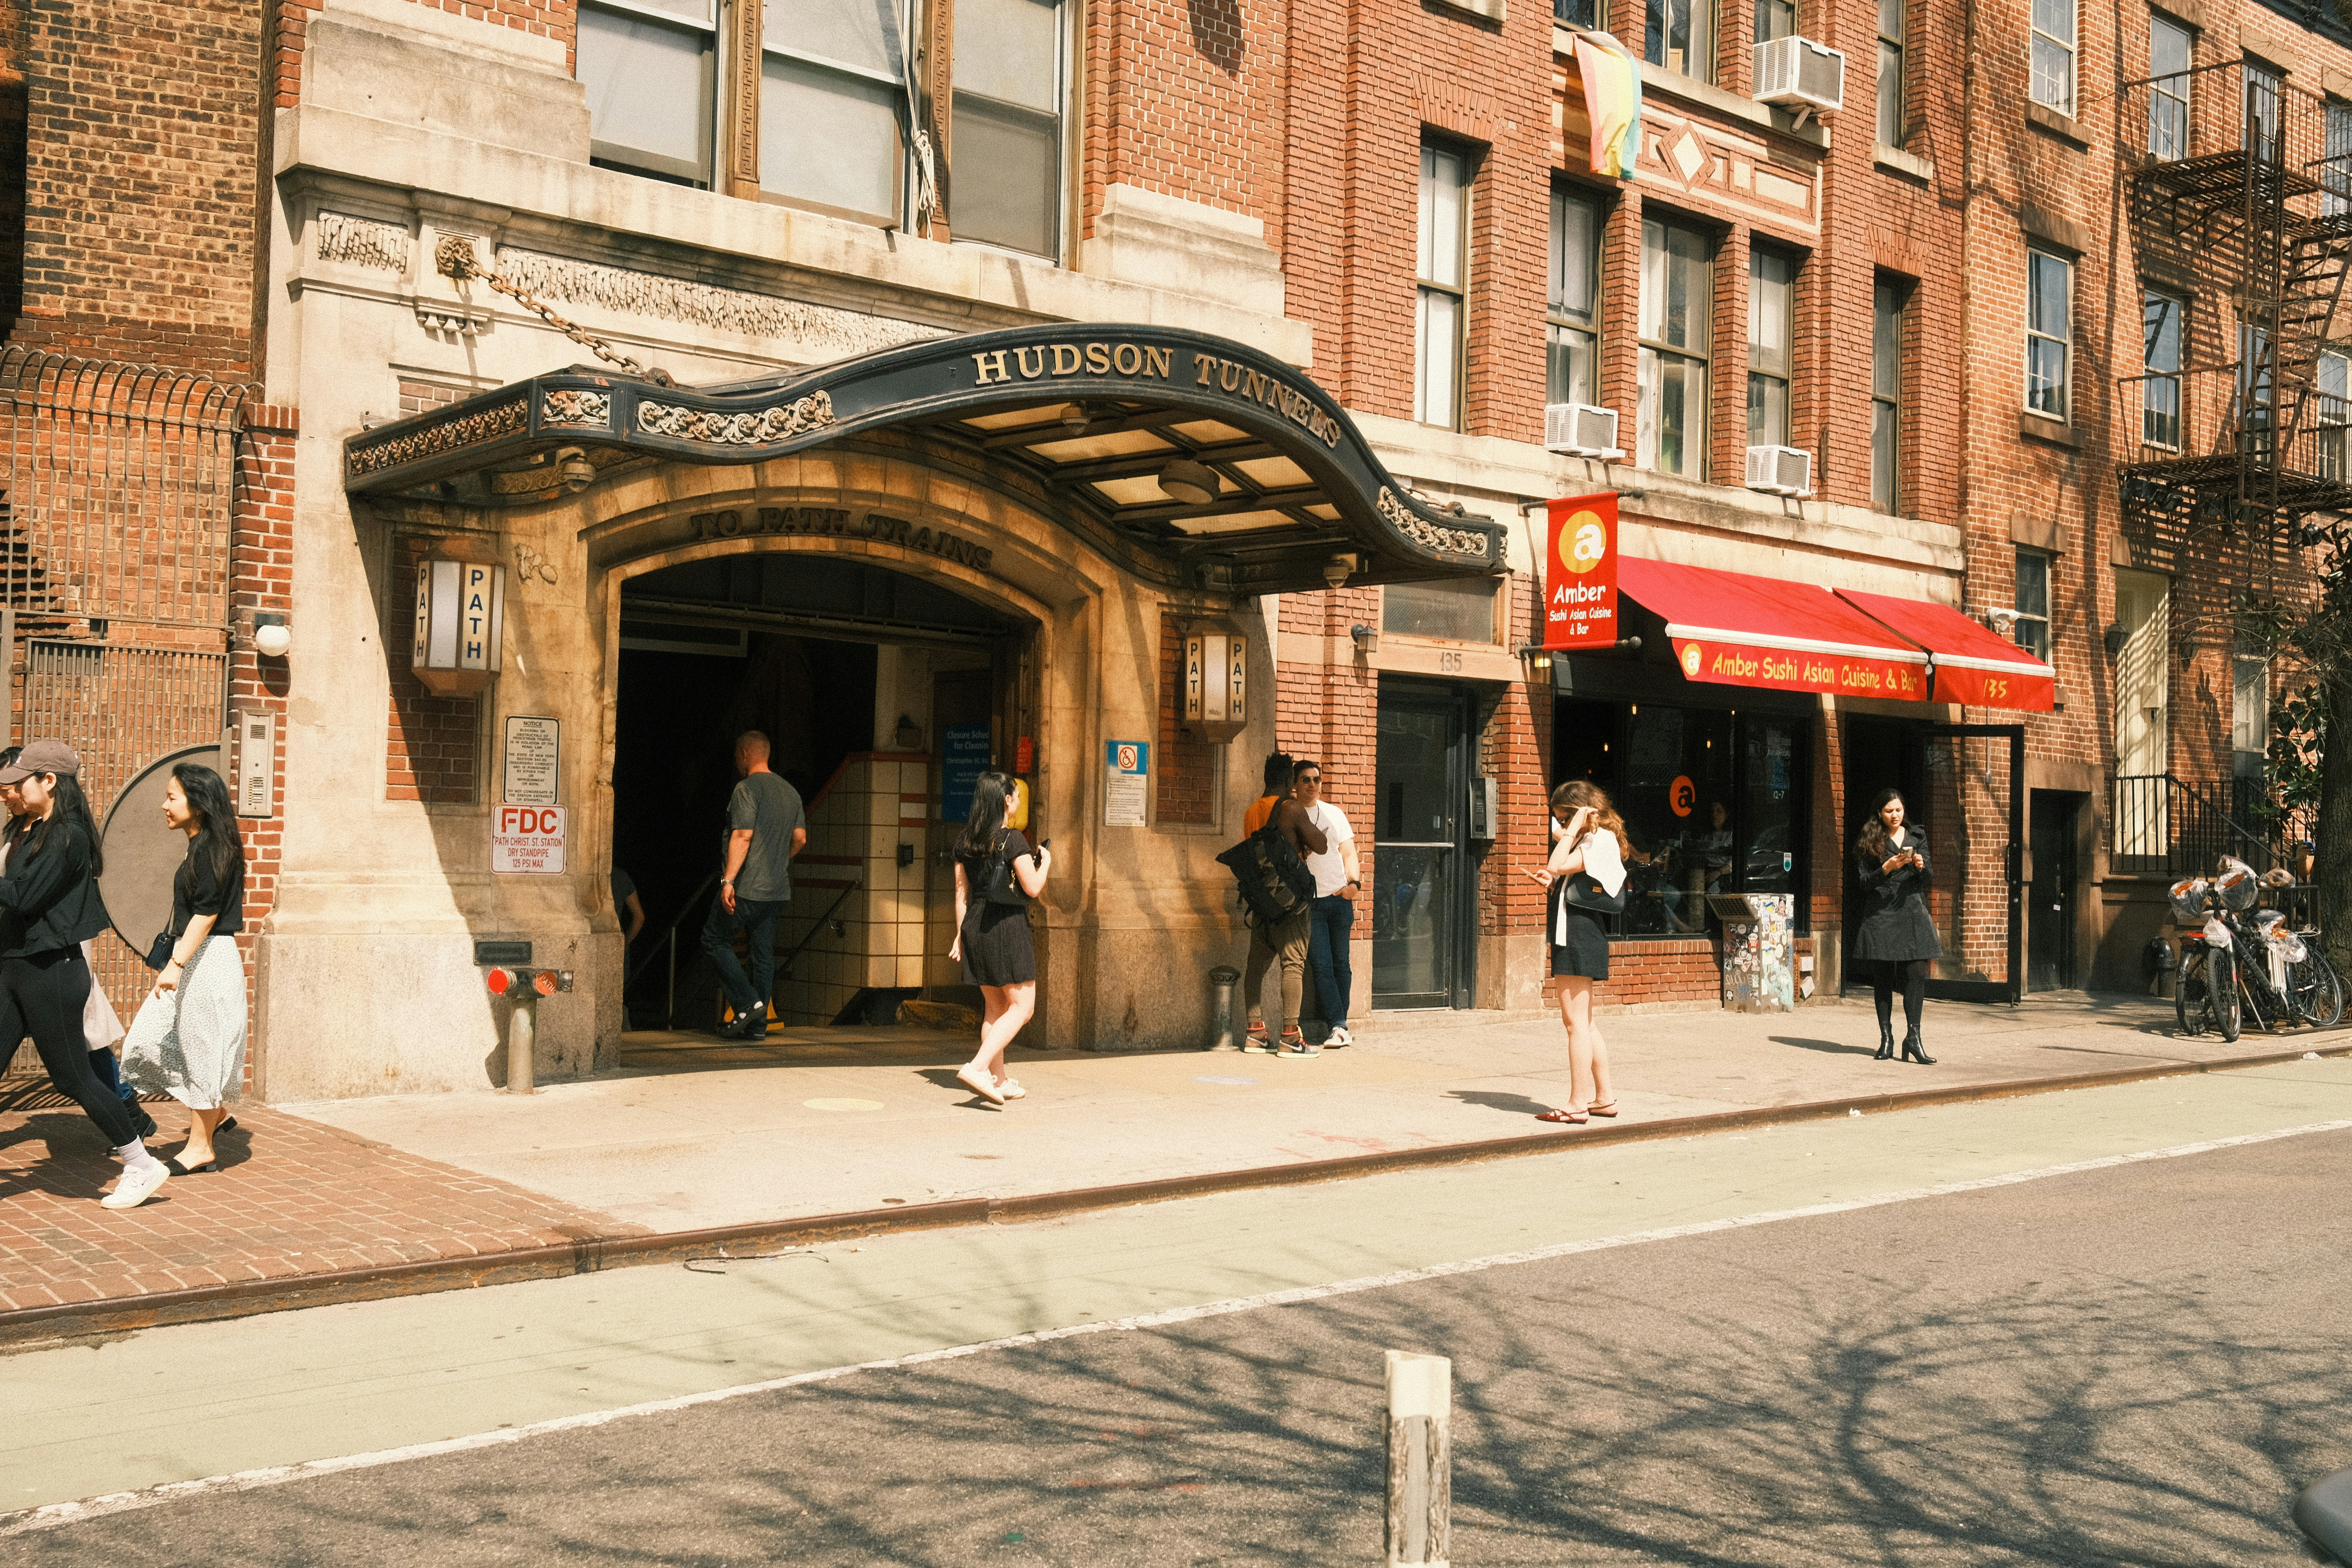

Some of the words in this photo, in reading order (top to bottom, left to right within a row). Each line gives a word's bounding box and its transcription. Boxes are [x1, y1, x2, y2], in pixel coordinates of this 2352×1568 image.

[971, 343, 1173, 384] HUDSON
[1194, 353, 1341, 449] TUNNELS
[691, 510, 742, 540] TO
[758, 508, 851, 535] PATH
[867, 514, 993, 570] TRAINS
[1574, 524, 1605, 560] a
[1553, 581, 1606, 603] Amber
[417, 569, 426, 657] PATH
[467, 570, 484, 658] PATH
[1550, 609, 1567, 622] Sushi
[1570, 608, 1586, 620] Asian
[1589, 607, 1611, 619] Cuisine
[1570, 623, 1574, 635] &
[1577, 623, 1588, 635] Bar
[1440, 652, 1462, 672] 135
[1687, 651, 1700, 670] a
[1712, 653, 1758, 677] Amber
[1762, 657, 1797, 680] Sushi
[1803, 662, 1834, 684] Asian
[1841, 665, 1880, 689] Cuisine
[1886, 669, 1897, 690] &
[1902, 670, 1917, 692] Bar
[1233, 643, 1242, 713] PATH
[1984, 679, 2007, 698] 135
[1774, 791, 1784, 799] 12-7
[501, 808, 557, 834] FDC
[495, 837, 508, 845] PATH
[510, 837, 530, 846] CHRIST.
[541, 838, 562, 847] STATION
[508, 848, 518, 856] DRY
[520, 848, 549, 857] STANDPIPE
[522, 859, 531, 867] PSI
[533, 859, 543, 868] MAX
[540, 975, 555, 991] PATH
